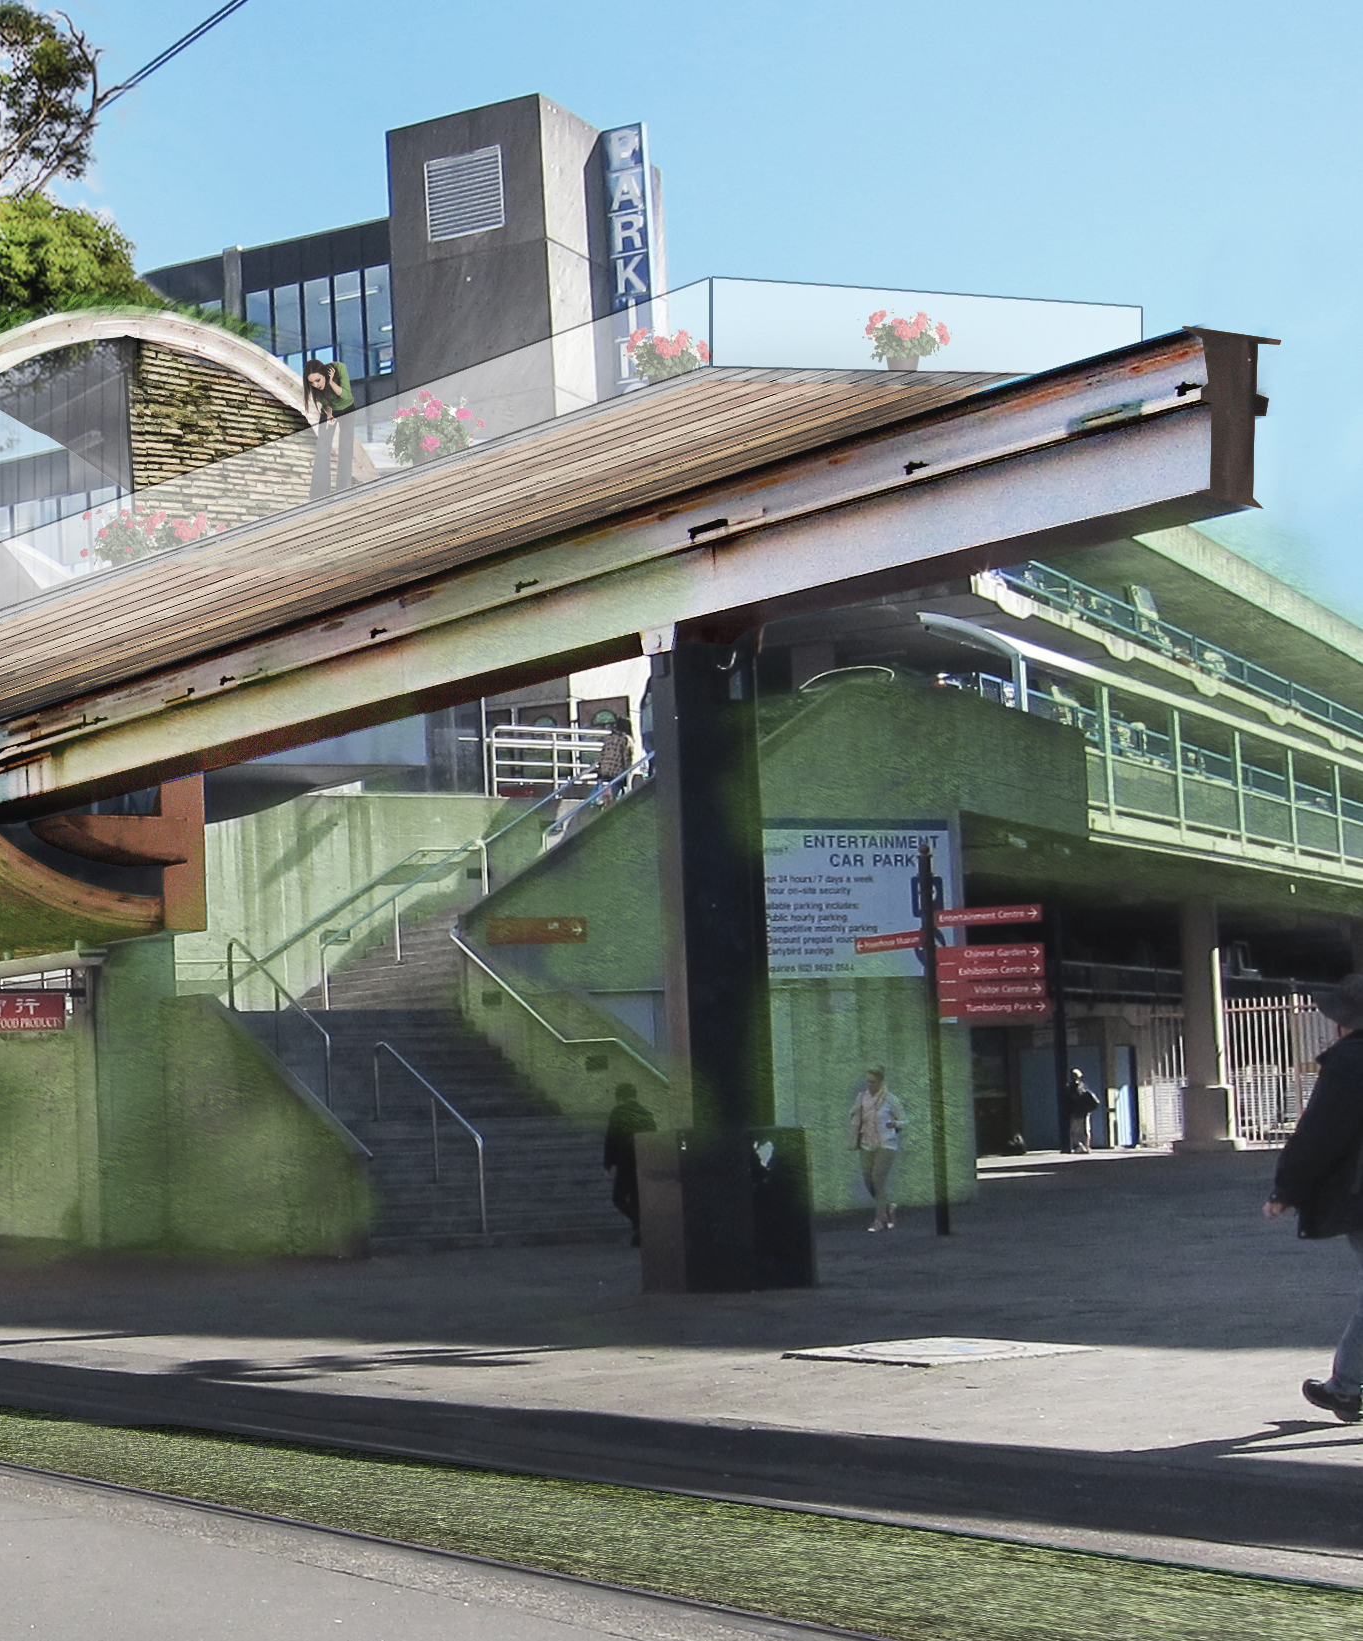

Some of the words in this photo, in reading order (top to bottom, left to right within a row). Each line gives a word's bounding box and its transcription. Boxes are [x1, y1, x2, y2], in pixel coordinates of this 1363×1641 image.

[609, 129, 651, 388] PARKI
[803, 835, 940, 849] ENTERTAINMENT
[829, 853, 864, 868] CAR
[872, 853, 917, 868] PARK
[825, 875, 844, 885] days
[853, 875, 874, 883] week
[819, 886, 852, 896] security
[793, 902, 824, 912] parking
[790, 914, 816, 924] hourly
[817, 914, 848, 924] parking
[938, 911, 996, 923] Entertainment
[997, 910, 1025, 920] Centre
[814, 924, 847, 934] monthly
[848, 924, 878, 934] parking
[802, 936, 833, 945] prepaid
[803, 947, 835, 957] savings
[963, 949, 996, 958] Chinese
[996, 948, 1027, 957] Garden
[958, 967, 999, 976] Exhibition
[1000, 966, 1028, 974] Centre
[973, 985, 999, 994] Visitor
[1001, 985, 1029, 994] Centre
[965, 1004, 1013, 1013] Tumbalong
[1013, 1003, 1033, 1011] Park
[20, 1016, 64, 1029] PRODUCTS
